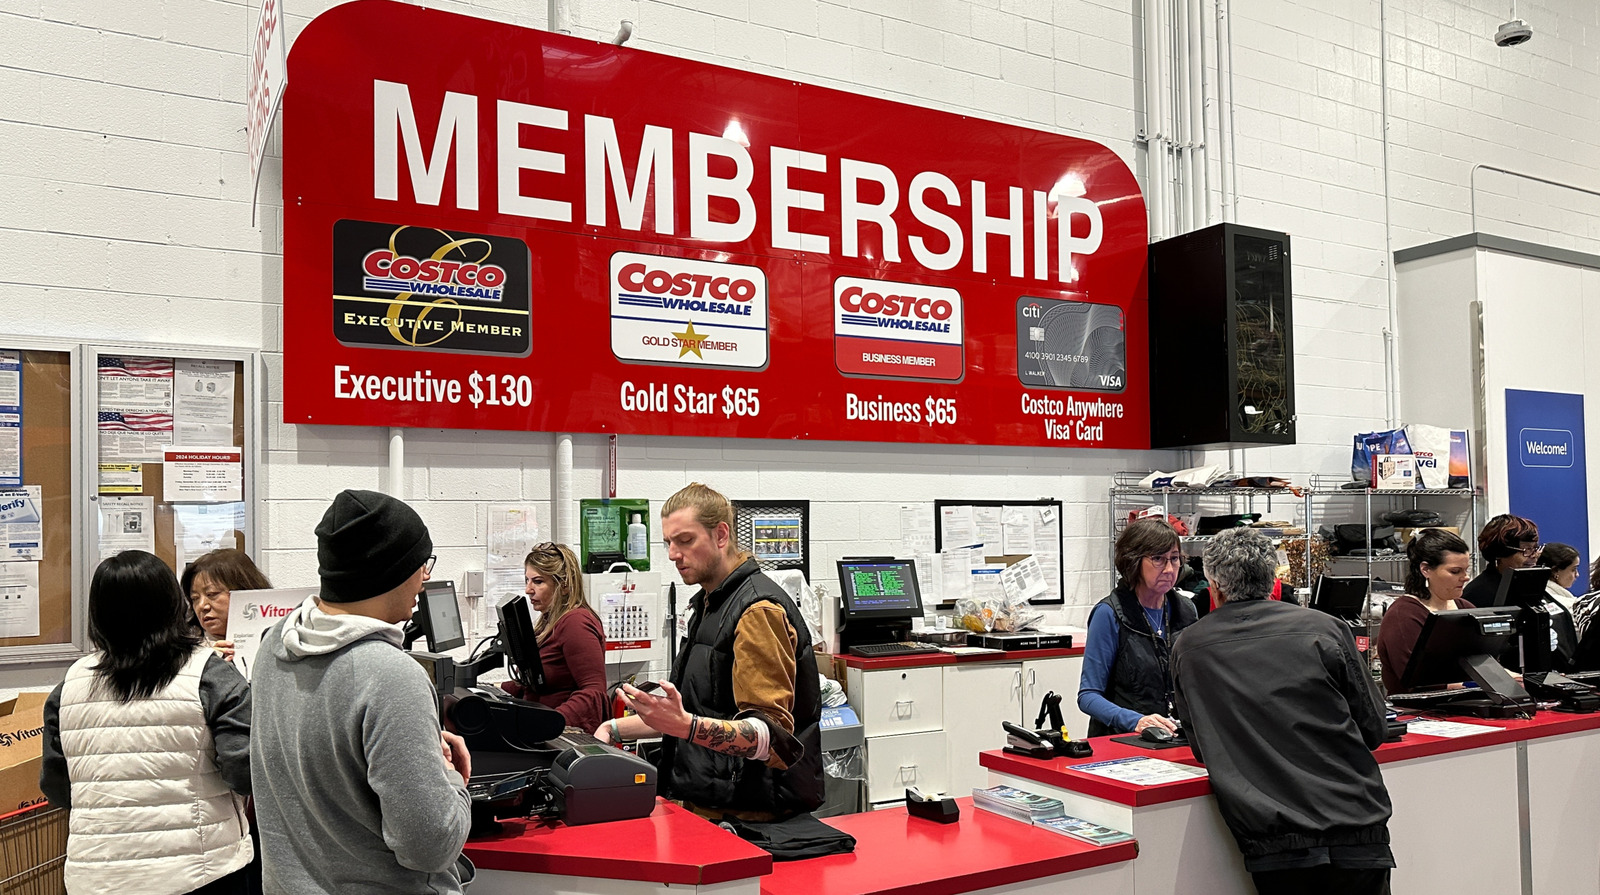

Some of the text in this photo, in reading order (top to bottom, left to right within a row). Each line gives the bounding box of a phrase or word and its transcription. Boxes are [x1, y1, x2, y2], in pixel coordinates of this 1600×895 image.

[374, 79, 1103, 283] MEMBERSHIP
[363, 250, 506, 288] COSTCO
[410, 282, 502, 300] WHOLESALE
[617, 263, 756, 302] COSTCO
[662, 297, 752, 316] WHOLESALE
[839, 286, 953, 321] COSTCO
[1022, 304, 1041, 318] citi
[344, 312, 522, 336] EXECUTIVE MEMBER
[877, 317, 950, 333] WHOLESALE
[642, 336, 738, 351] GOLD STAR MEMBER
[862, 353, 936, 366] BUSINESS MEMBER
[1024, 352, 1089, 363] 4100 3901 2345 6789
[334, 365, 533, 408] Executive $130
[1098, 374, 1122, 387] VISA
[620, 381, 760, 419] Gold Star $65
[1021, 393, 1124, 421] Costco Anywhere
[846, 393, 957, 427] Business $65
[1075, 420, 1103, 441] Card
[1526, 441, 1568, 456] Welcome!
[1417, 458, 1437, 468] vel
[260, 604, 295, 618] Vita
[10, 726, 45, 741] Vitam
